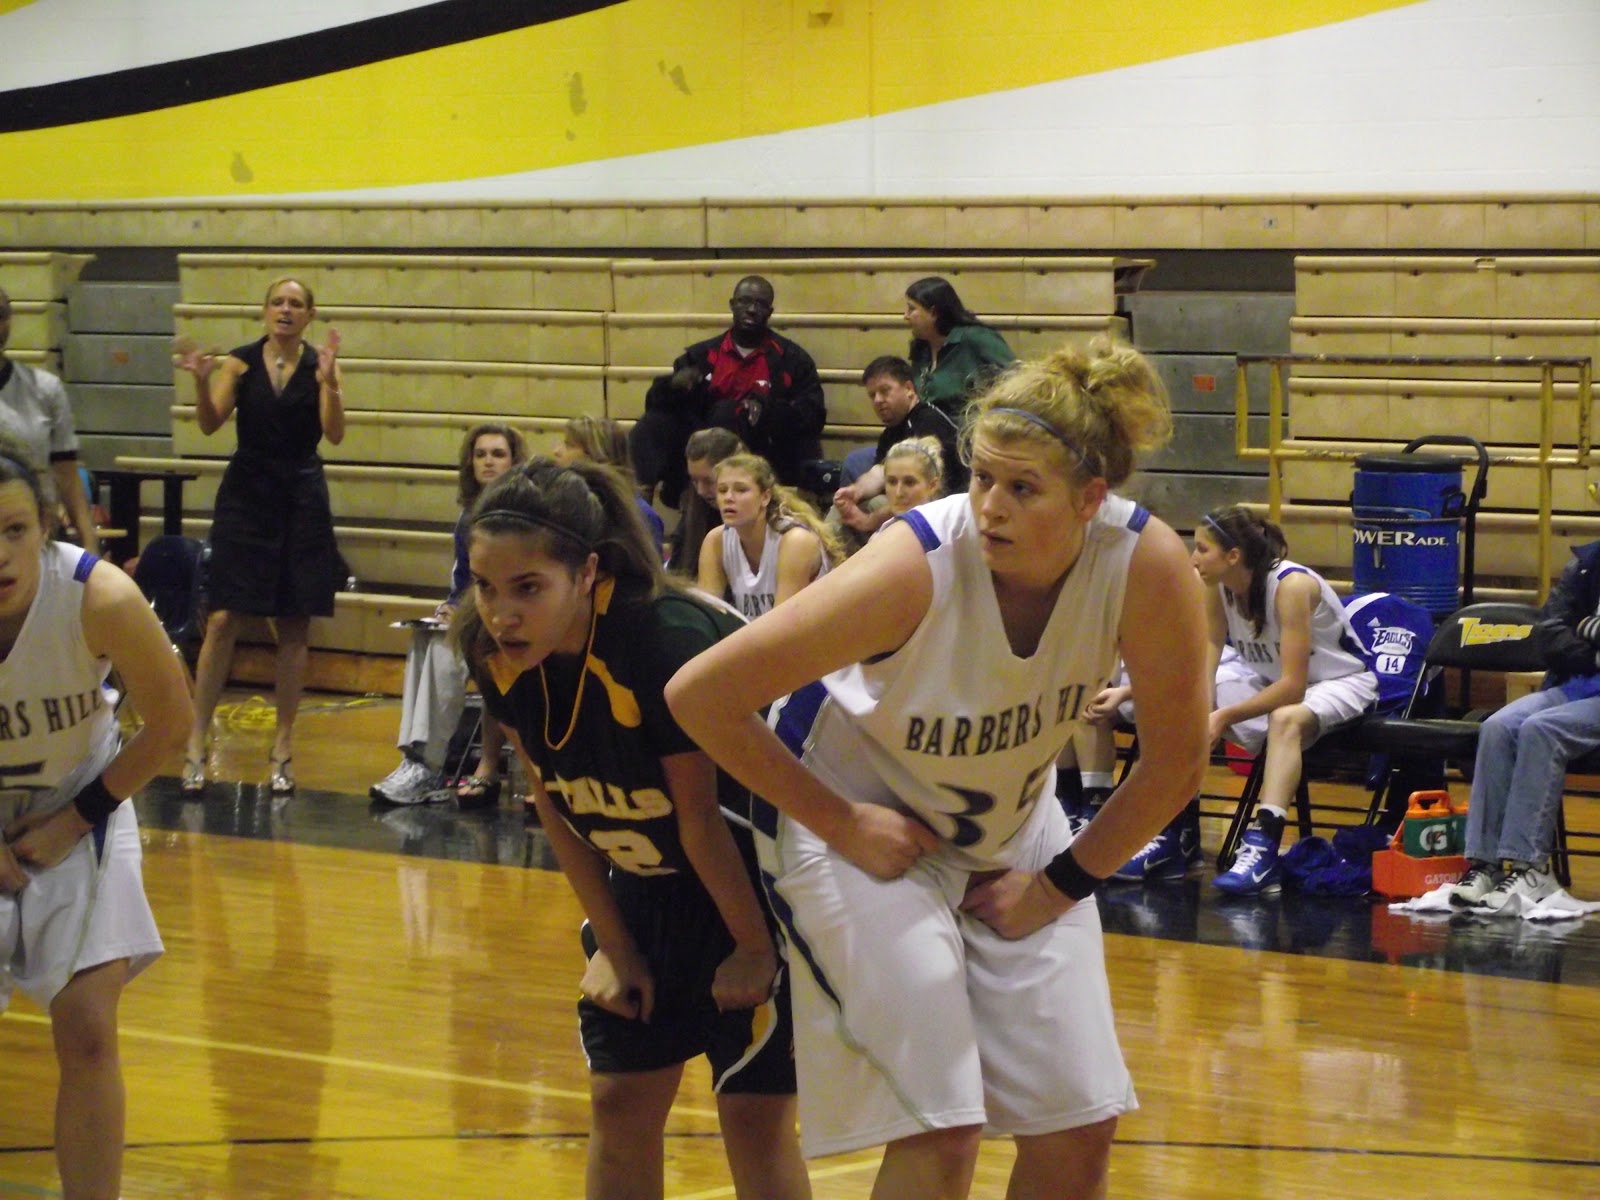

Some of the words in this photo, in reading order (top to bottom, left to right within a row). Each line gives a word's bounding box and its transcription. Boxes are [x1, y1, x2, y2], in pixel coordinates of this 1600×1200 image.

[1384, 656, 1399, 672] 14
[43, 688, 101, 733] HILL
[904, 692, 1043, 757] BARBERS
